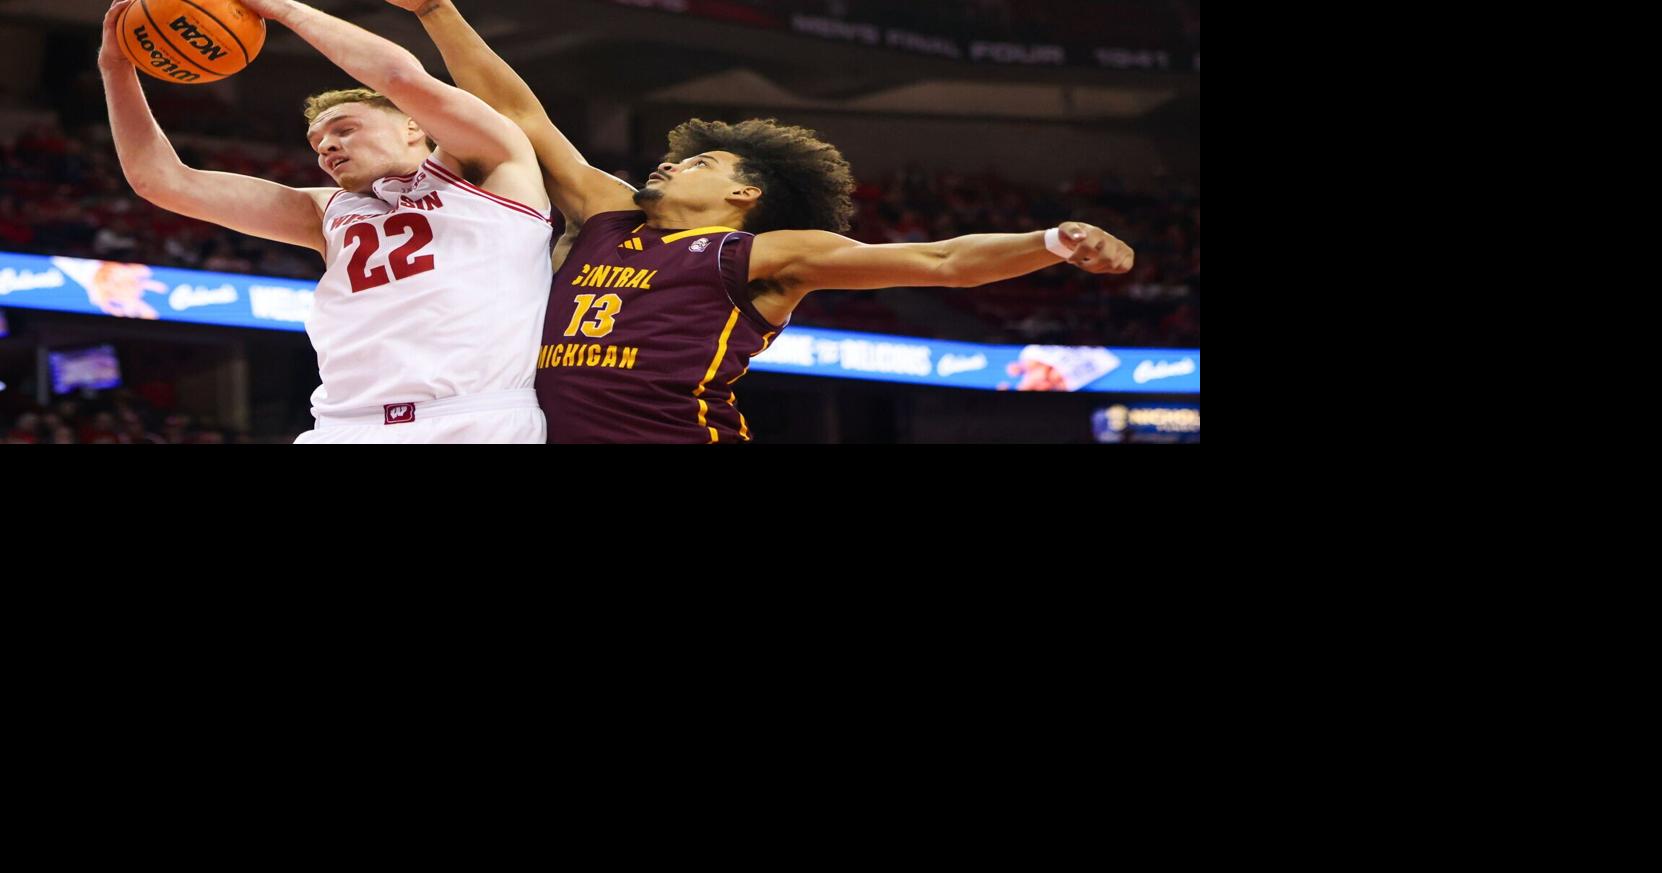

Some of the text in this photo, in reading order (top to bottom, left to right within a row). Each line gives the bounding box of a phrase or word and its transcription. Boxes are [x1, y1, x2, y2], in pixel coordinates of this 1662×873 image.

[133, 25, 201, 82] Wilson
[169, 15, 228, 61] NCAA
[970, 41, 1065, 63] FOUR
[343, 212, 435, 293] 22
[563, 293, 623, 338] 13
